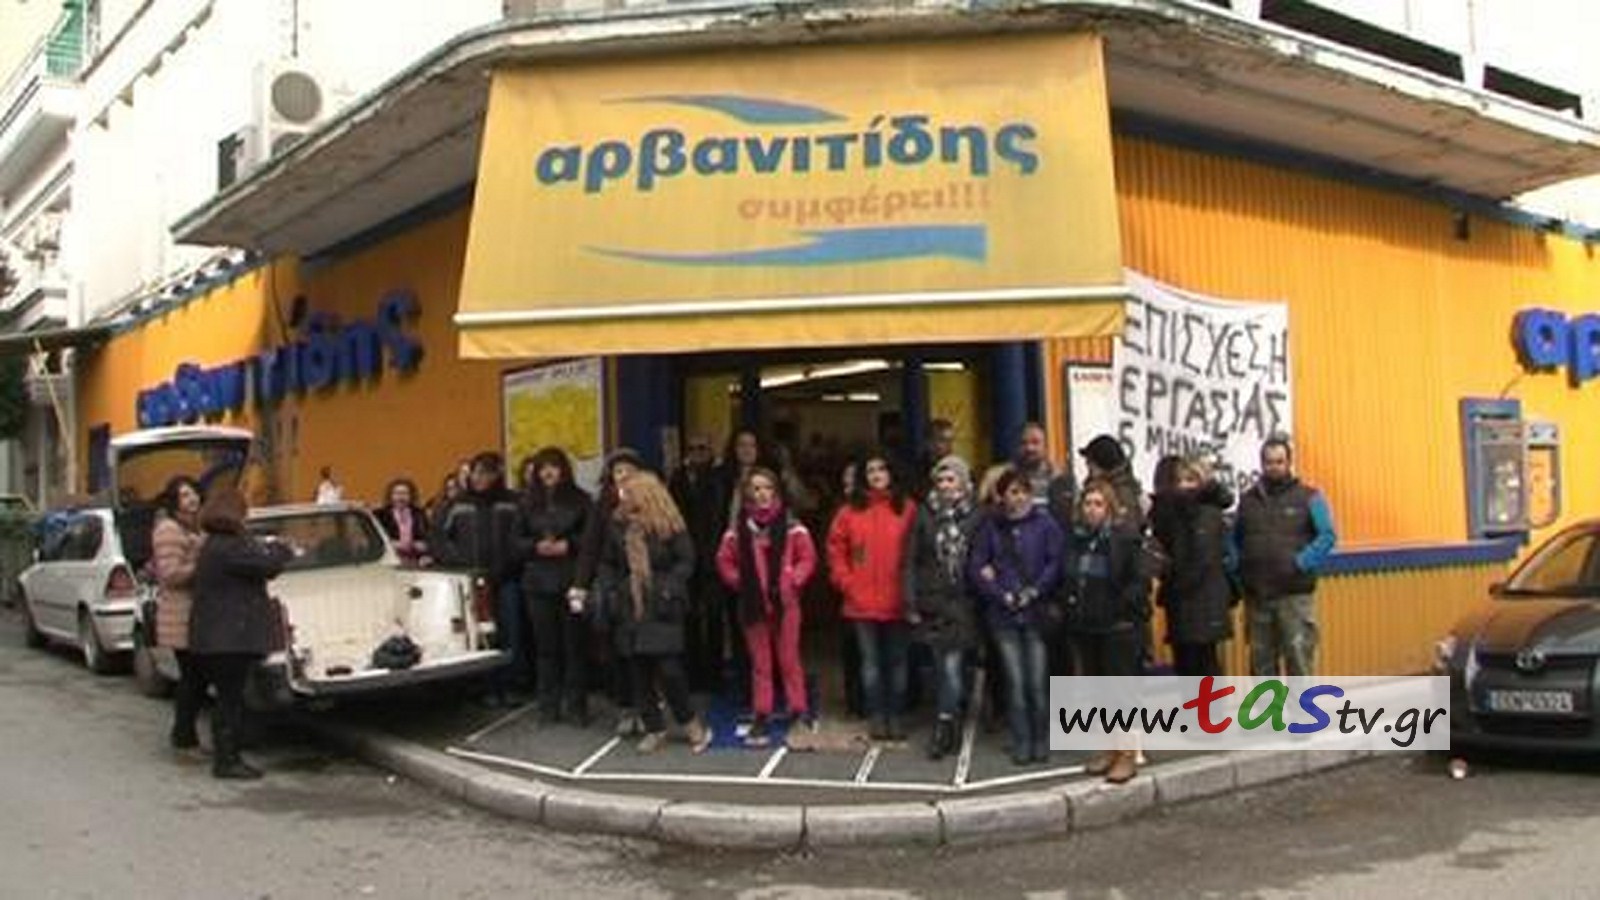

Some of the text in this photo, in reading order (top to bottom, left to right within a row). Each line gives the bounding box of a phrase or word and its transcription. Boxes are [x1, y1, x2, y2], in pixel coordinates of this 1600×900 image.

[535, 113, 1041, 193] αρβανιτίδης
[738, 182, 992, 227] συμφέρει!!!
[1121, 296, 1289, 385] ΕΠΙΣΧΕΣΗ
[1119, 366, 1288, 439] ΕΡΓΑΣΙΑΣ
